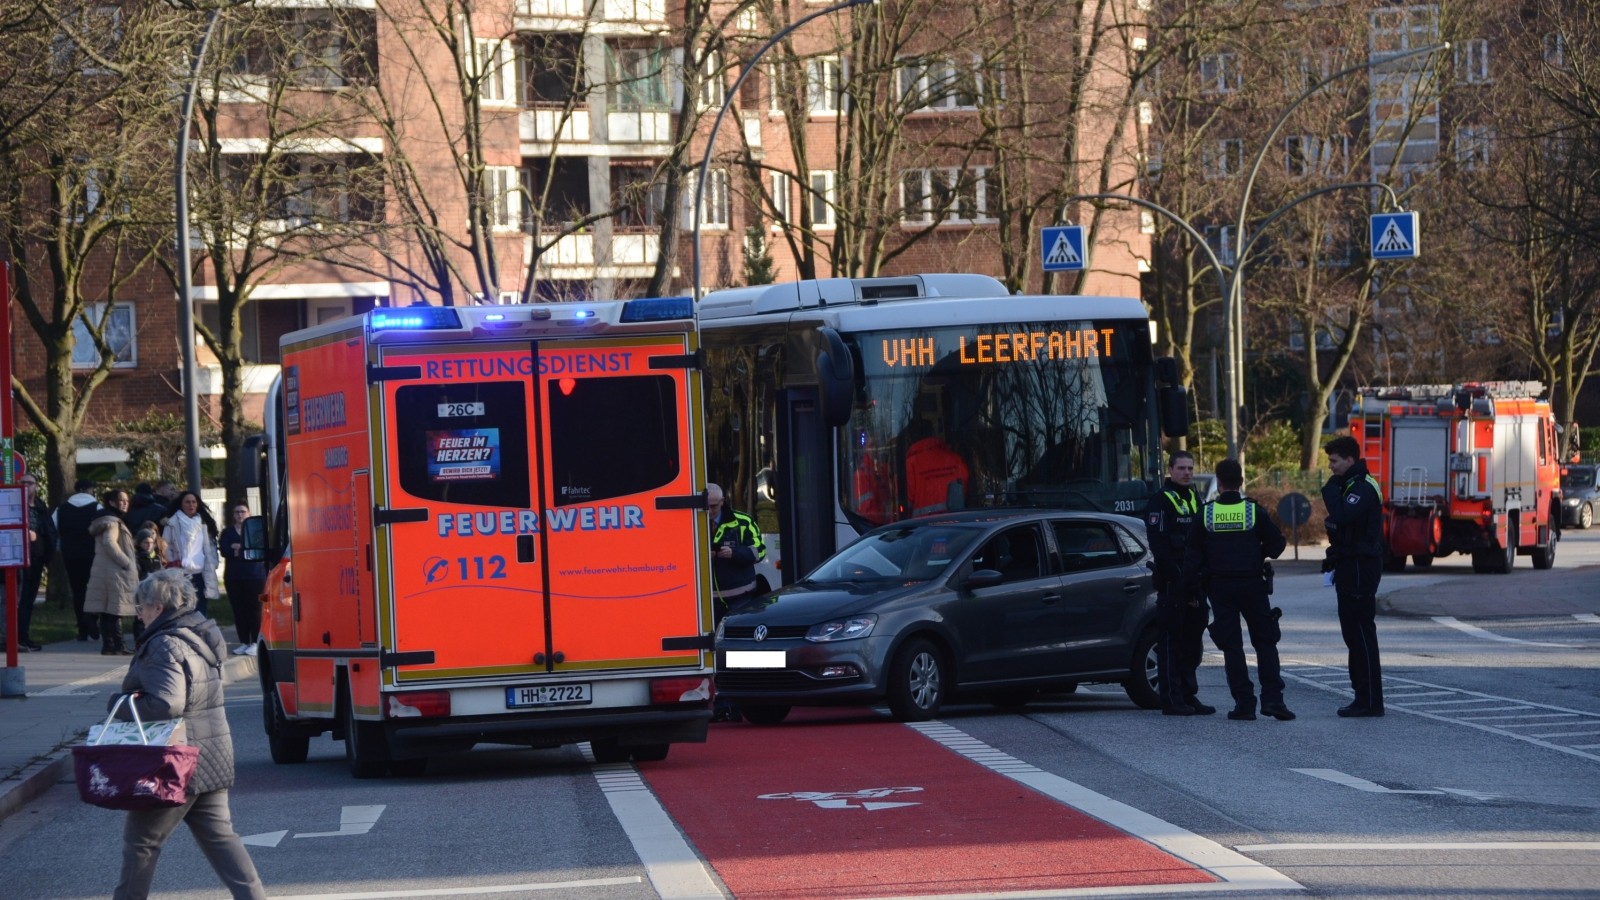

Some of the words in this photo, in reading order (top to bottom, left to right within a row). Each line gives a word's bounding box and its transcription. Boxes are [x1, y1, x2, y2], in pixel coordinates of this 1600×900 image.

[882, 337, 935, 367] VHH
[959, 328, 1114, 364] LEERFAHRT
[426, 352, 632, 379] RETTUNGSDIENST
[303, 391, 346, 432] FEUERWEHR
[447, 404, 474, 416] 26C
[439, 437, 471, 448] FEUER
[473, 436, 486, 447] IM
[436, 449, 490, 461] HERZEN?
[1115, 500, 1136, 512] 2031
[437, 505, 645, 538] FEUERWEHR
[1215, 512, 1244, 522] POLIZEI
[457, 555, 507, 580] 112
[559, 563, 677, 576] www.feuerwehr.hamburg.de
[521, 689, 540, 703] HH
[549, 686, 583, 701] 2722
